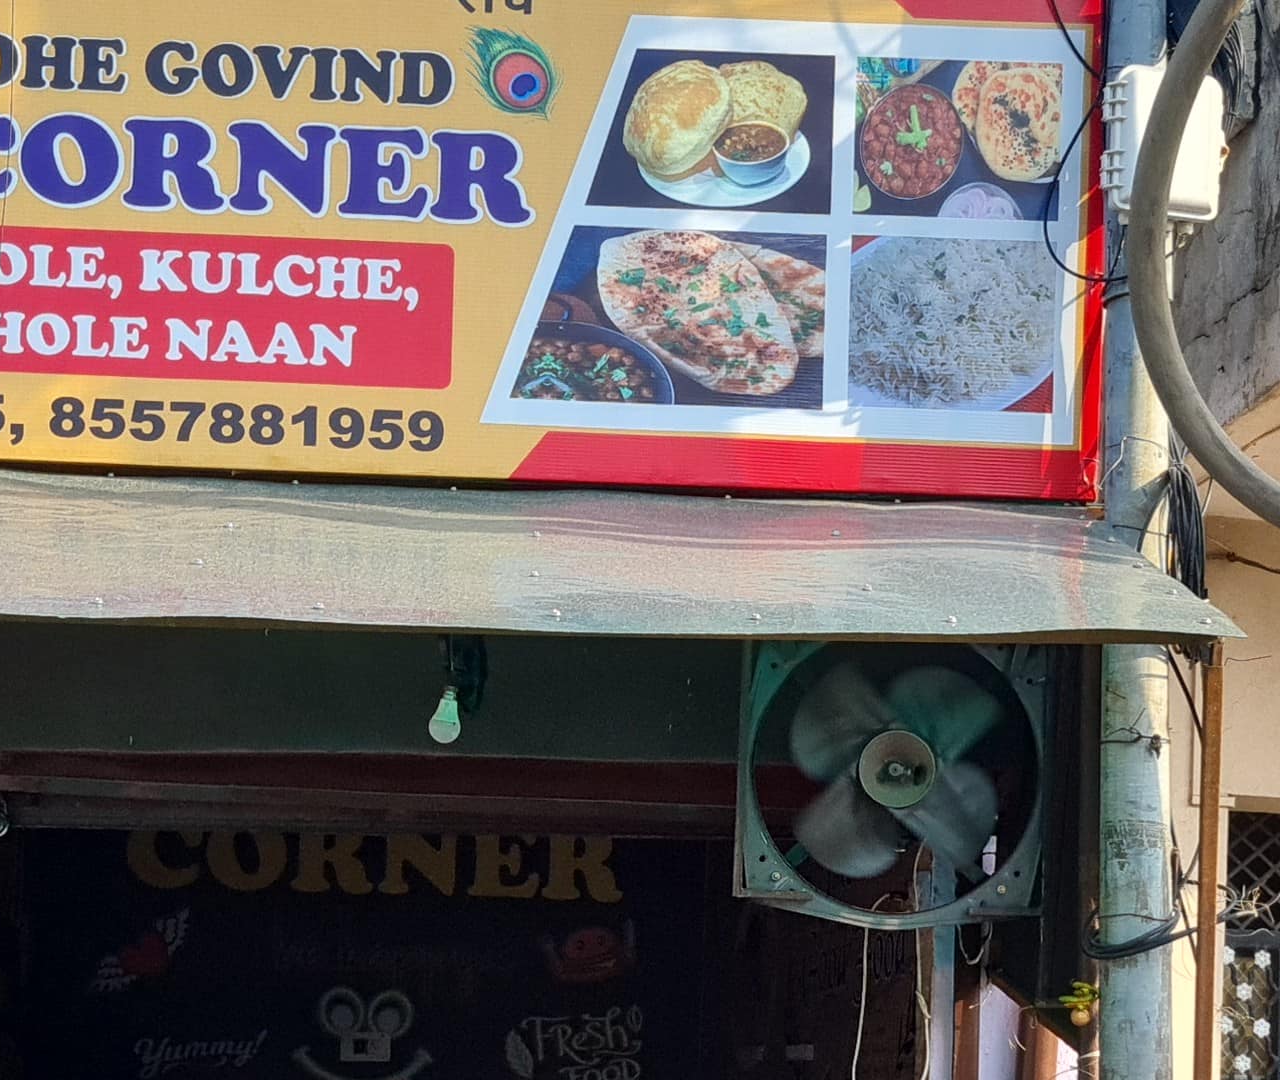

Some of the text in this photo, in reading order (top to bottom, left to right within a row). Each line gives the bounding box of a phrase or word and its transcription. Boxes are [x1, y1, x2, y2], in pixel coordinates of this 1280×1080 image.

[144, 40, 455, 107] GOVIND
[138, 248, 419, 311] KULCHE,
[165, 318, 357, 368] NAAN
[49, 396, 445, 453] 8557881959
[127, 829, 624, 902] CORNER
